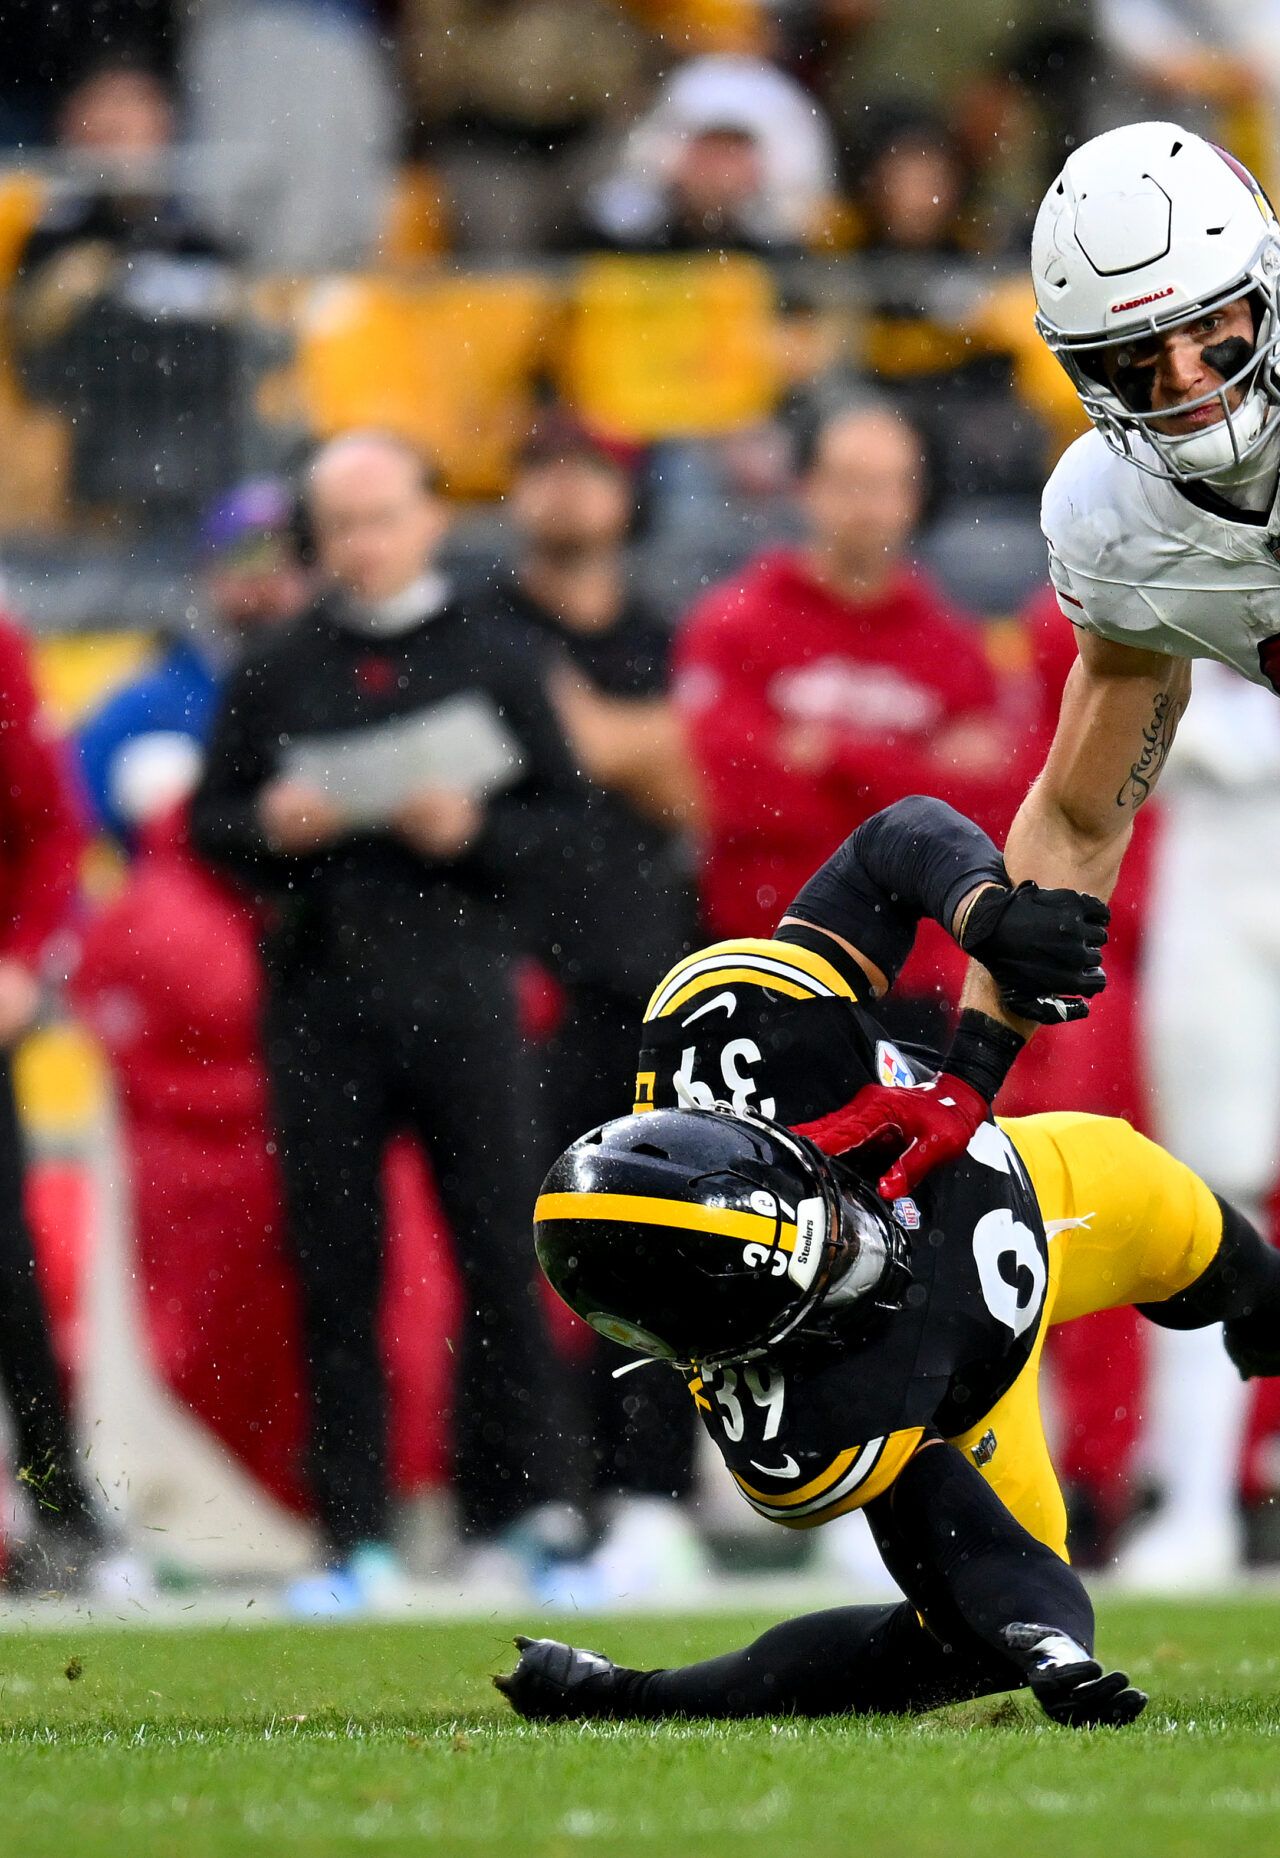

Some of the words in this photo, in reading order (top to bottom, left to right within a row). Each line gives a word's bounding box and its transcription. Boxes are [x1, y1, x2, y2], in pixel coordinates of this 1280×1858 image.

[1110, 287, 1174, 313] CARDINALS
[797, 1219, 814, 1265] Steelers
[700, 1366, 786, 1443] 39
